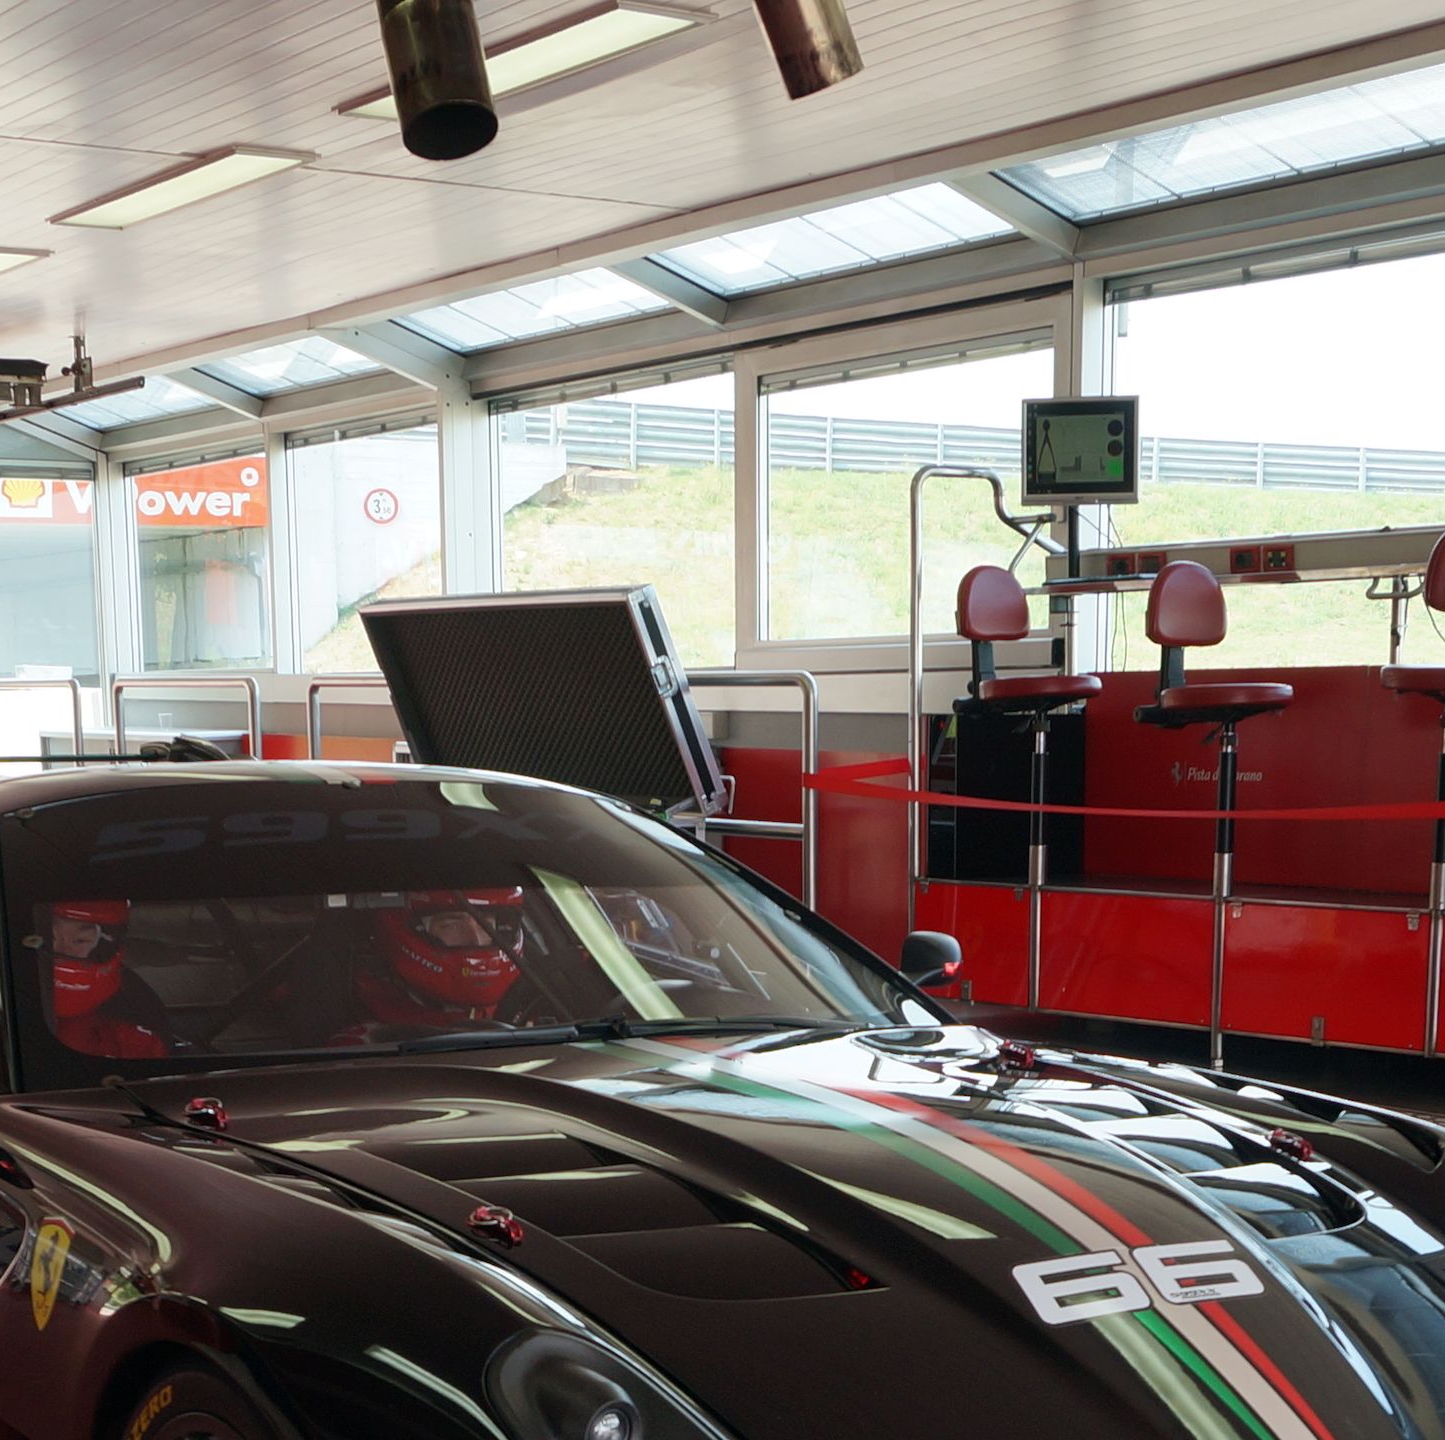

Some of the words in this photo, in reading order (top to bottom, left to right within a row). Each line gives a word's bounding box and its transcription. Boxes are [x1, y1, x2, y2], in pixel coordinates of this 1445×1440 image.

[132, 484, 251, 517] ower
[1187, 767, 1211, 780] Pista
[1012, 1240, 1264, 1325] 66
